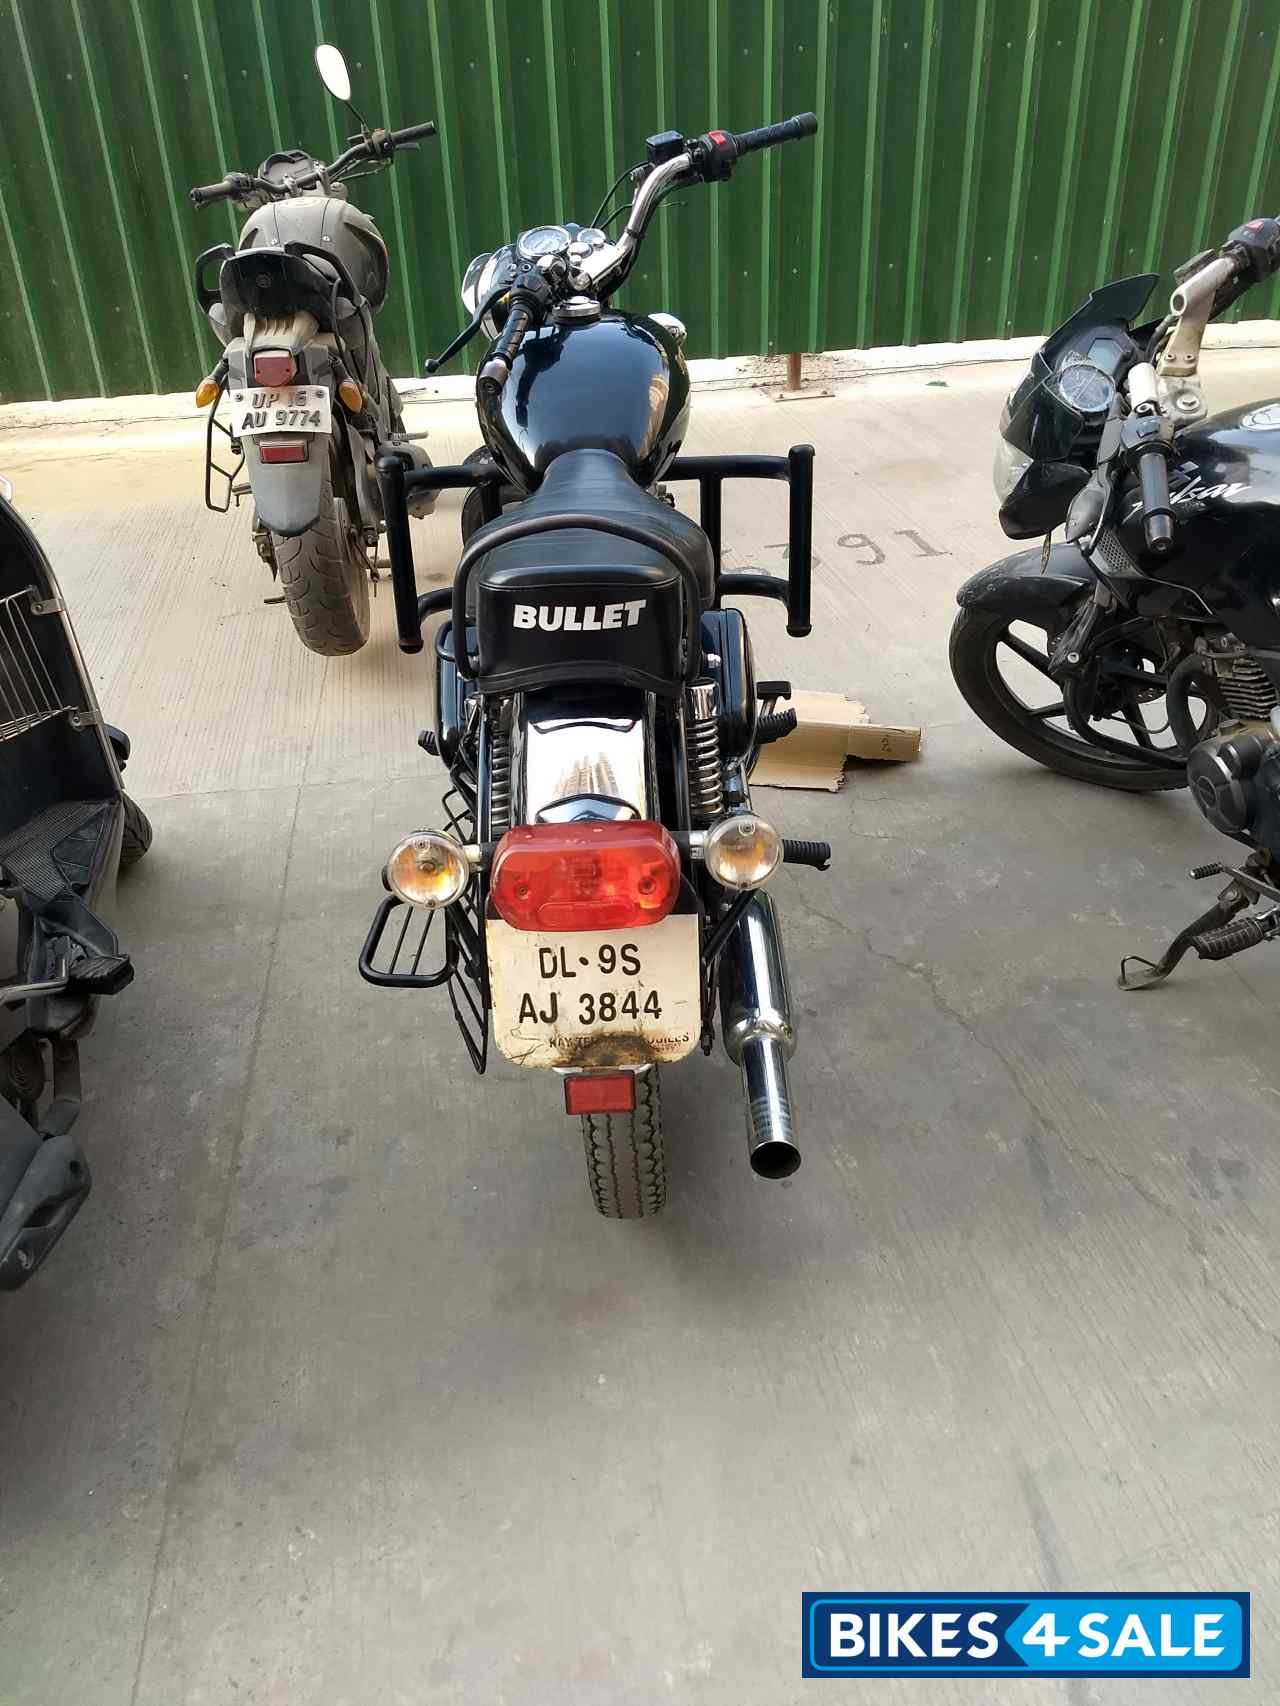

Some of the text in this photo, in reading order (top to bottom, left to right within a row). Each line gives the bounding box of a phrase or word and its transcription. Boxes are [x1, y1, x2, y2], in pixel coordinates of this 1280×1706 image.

[252, 392, 280, 408] UP
[242, 410, 321, 430] AU 9774
[513, 599, 647, 631] BULLET
[518, 990, 663, 1025] AJ 3844
